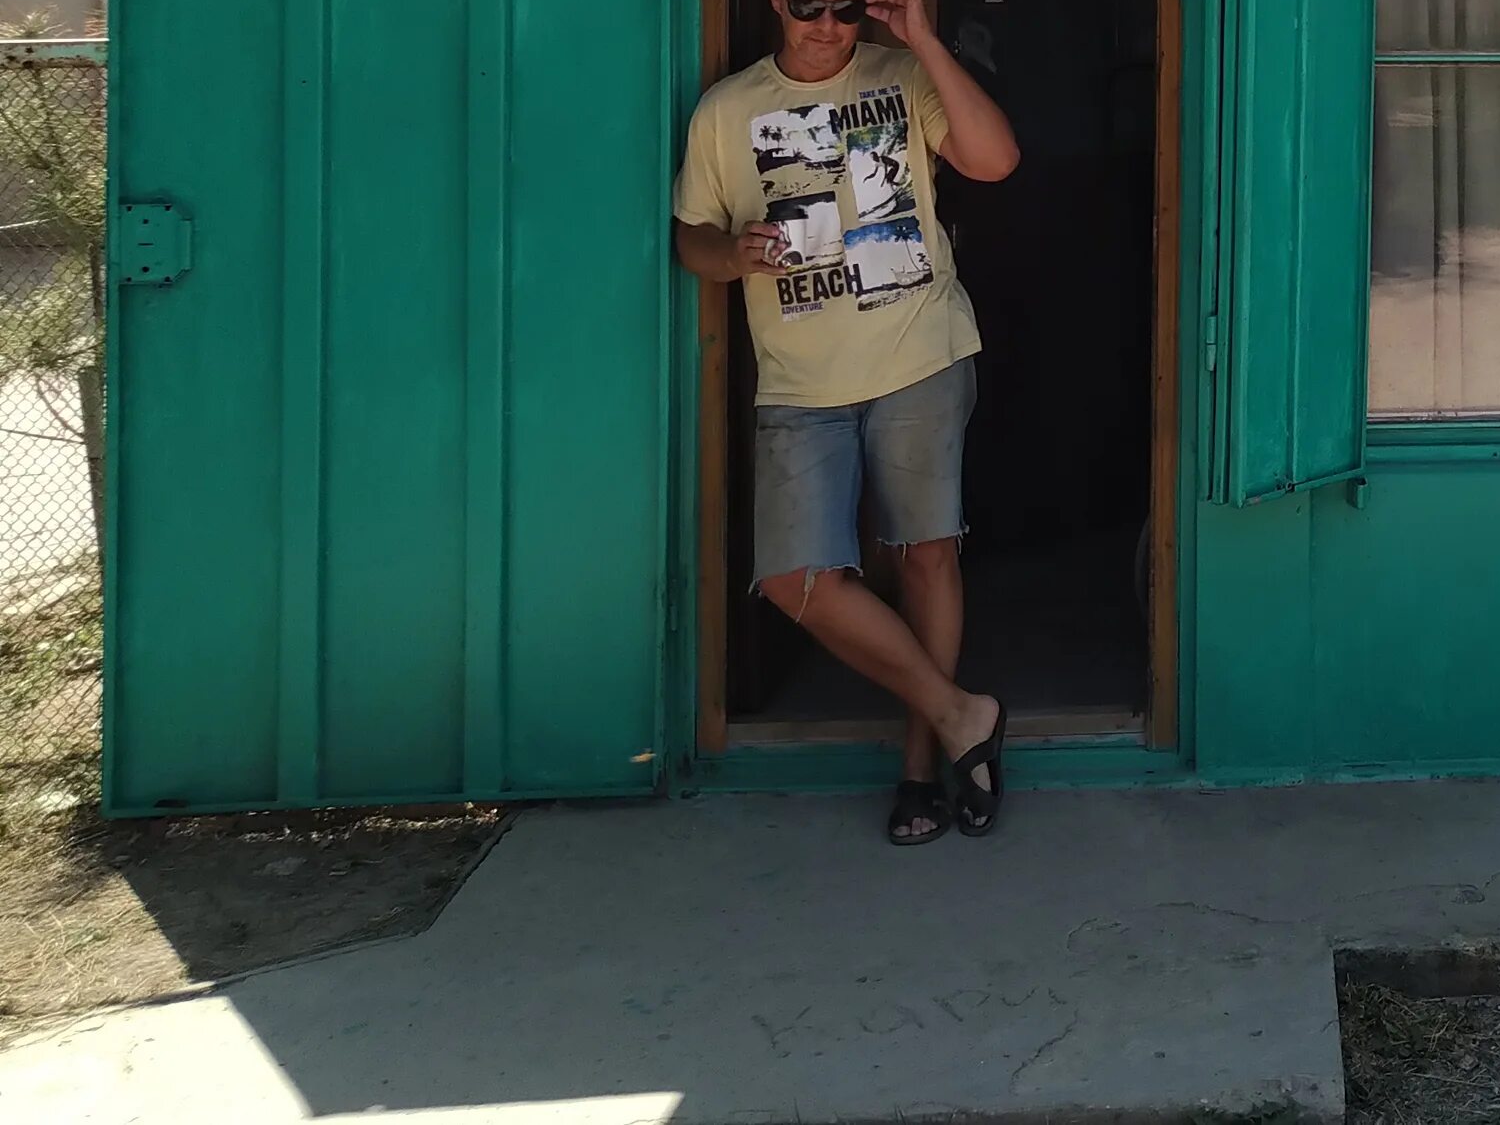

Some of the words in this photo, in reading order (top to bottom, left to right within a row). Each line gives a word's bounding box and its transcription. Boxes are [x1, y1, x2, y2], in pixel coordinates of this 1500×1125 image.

[859, 89, 875, 99] TAKE
[878, 87, 888, 96] ME
[891, 84, 901, 93] TO
[828, 93, 908, 135] MIAMI
[776, 264, 863, 306] BEACH
[781, 301, 824, 315] ADVENTURE
